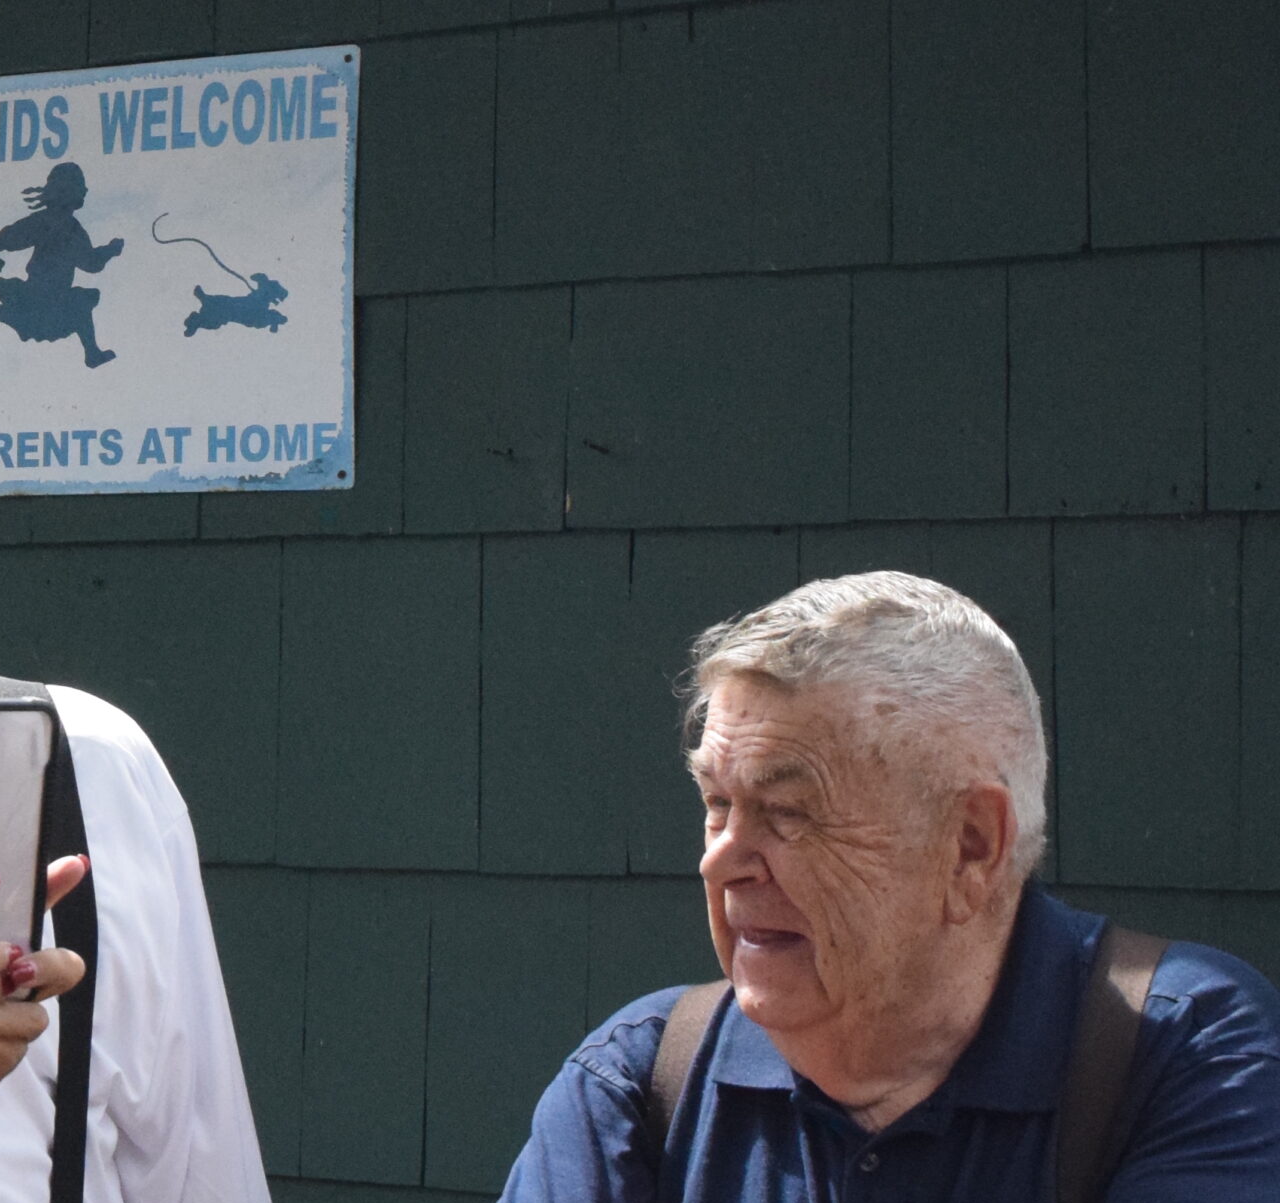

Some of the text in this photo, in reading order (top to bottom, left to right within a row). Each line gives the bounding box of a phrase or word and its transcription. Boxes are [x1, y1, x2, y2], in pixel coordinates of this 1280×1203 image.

[99, 74, 339, 155] WELCOME
[137, 427, 191, 464] AT
[207, 423, 338, 463] HOME
